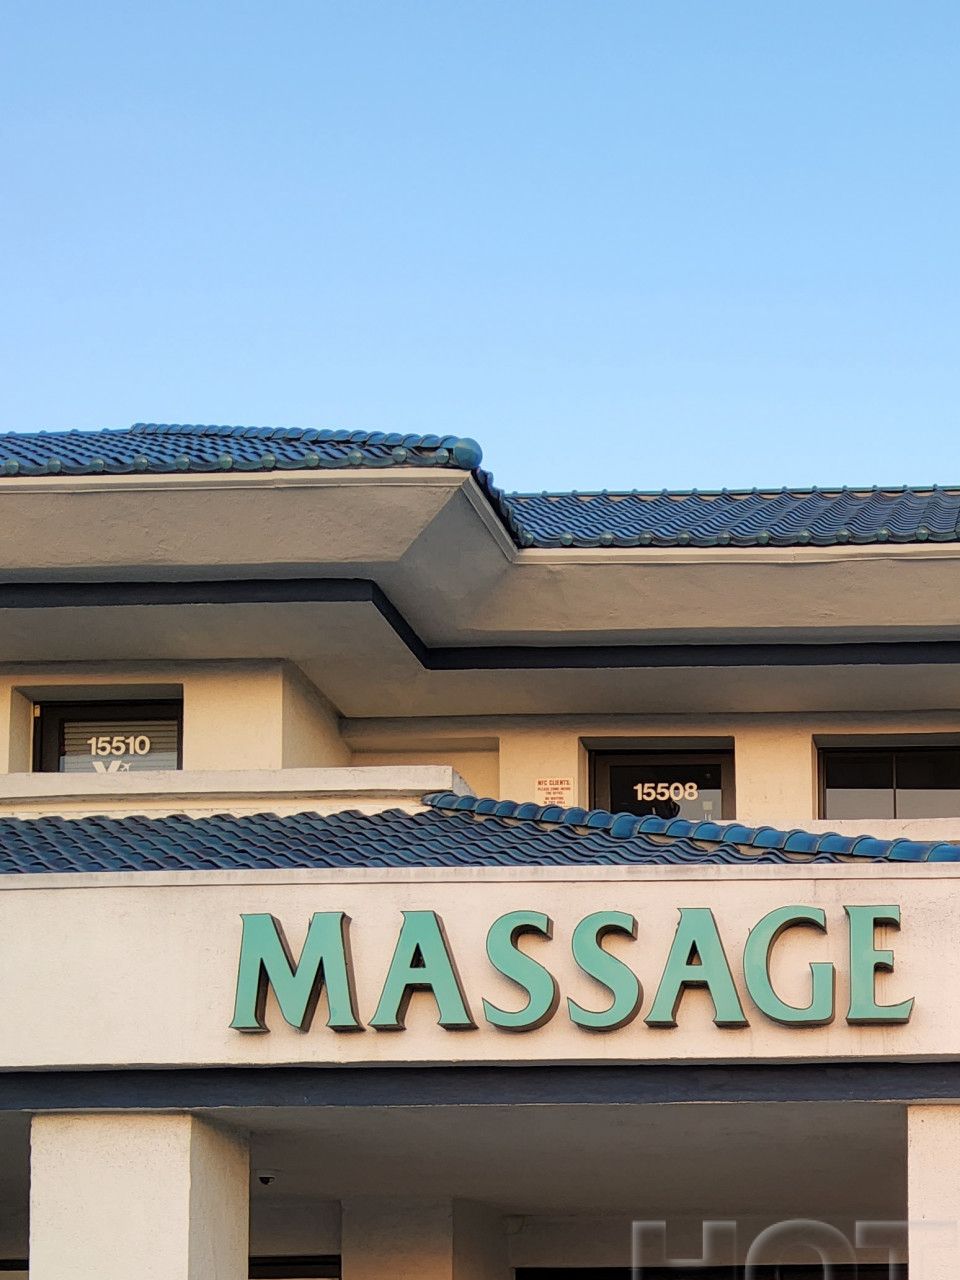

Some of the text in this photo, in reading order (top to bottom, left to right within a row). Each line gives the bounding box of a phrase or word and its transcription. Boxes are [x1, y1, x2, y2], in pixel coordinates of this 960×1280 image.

[87, 735, 151, 756] 15510
[633, 782, 699, 801] 15508
[231, 904, 916, 1033] MASSAGE
